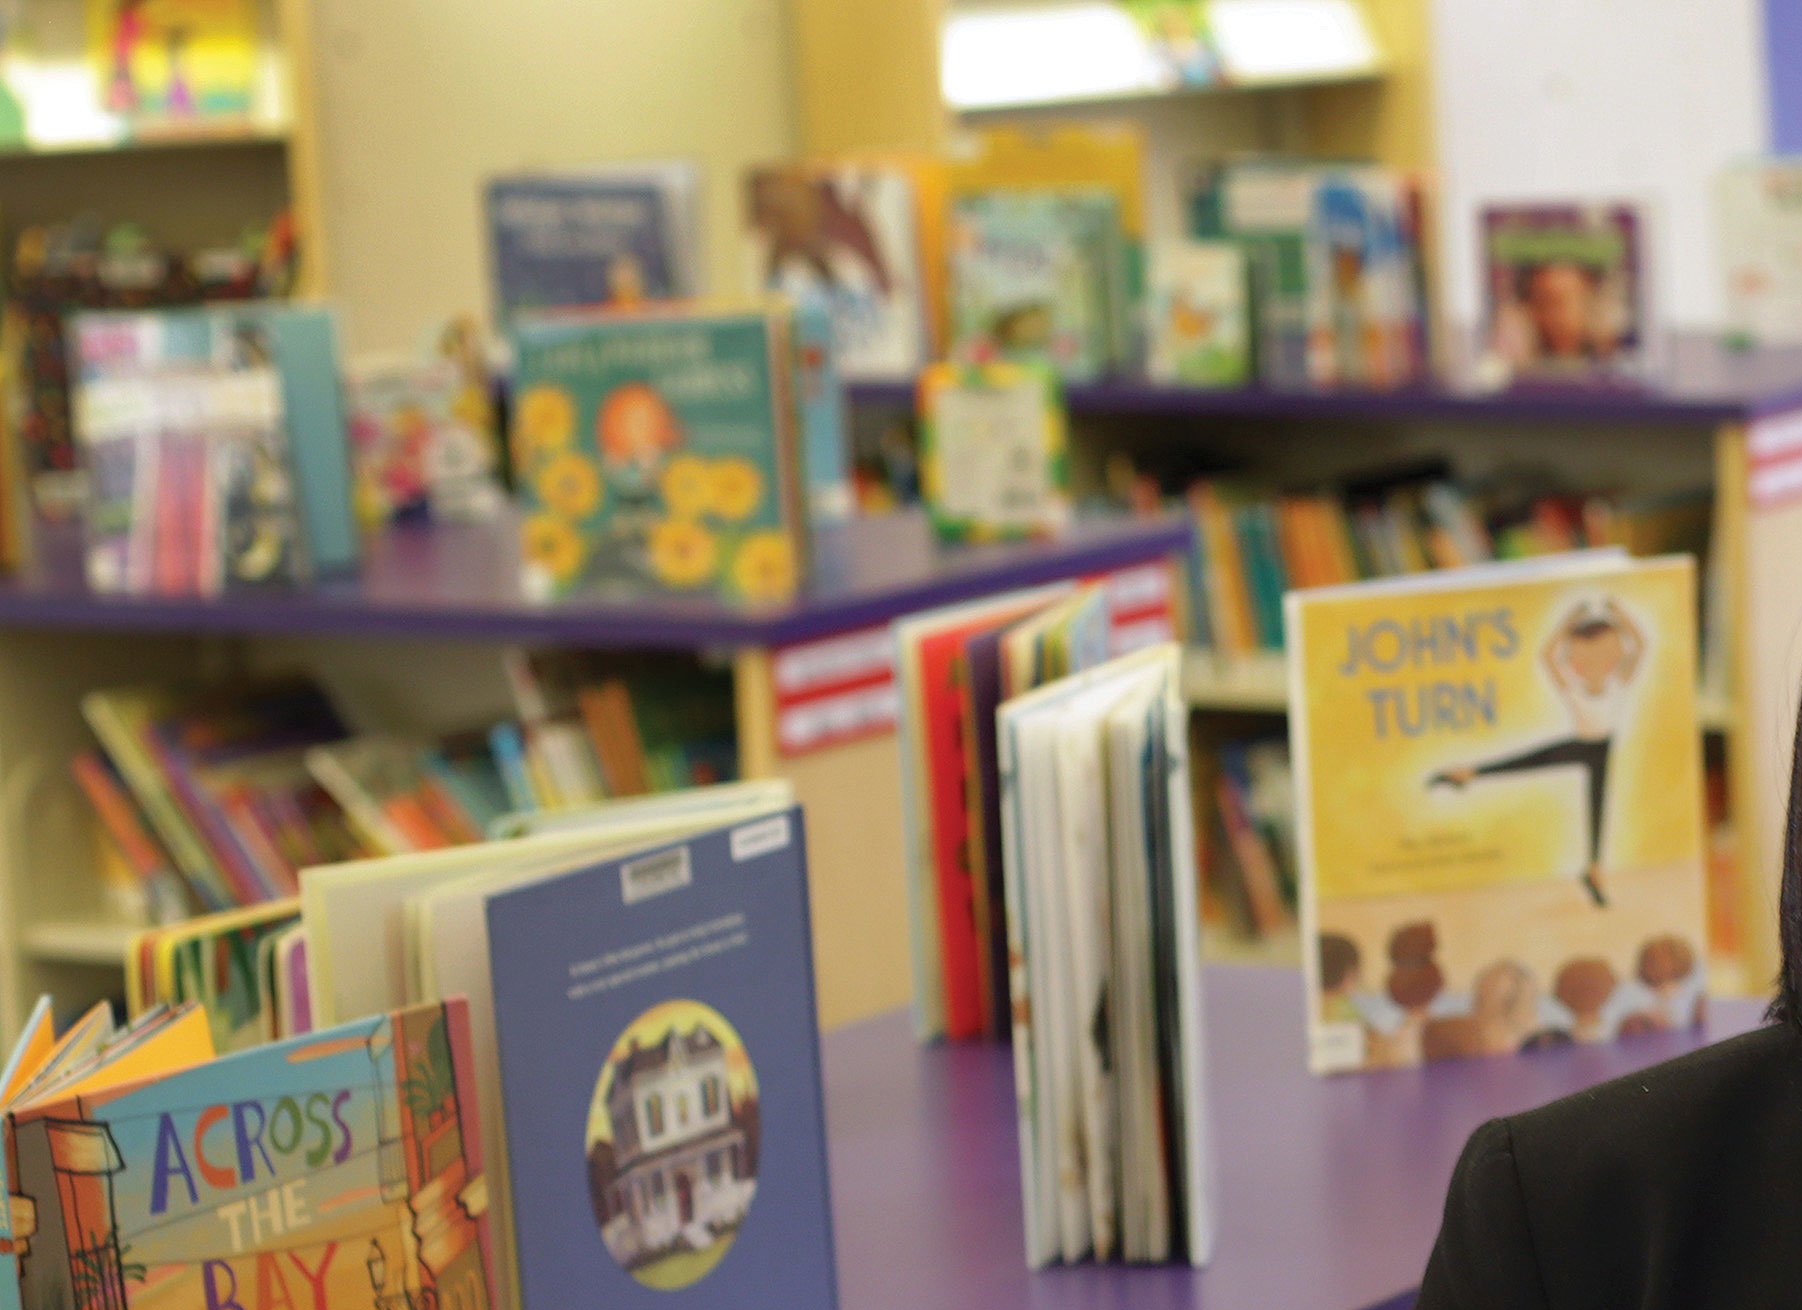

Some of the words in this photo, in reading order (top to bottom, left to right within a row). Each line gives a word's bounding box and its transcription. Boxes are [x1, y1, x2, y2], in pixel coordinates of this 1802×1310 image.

[1339, 607, 1520, 676] JOHN'S
[1366, 676, 1498, 738] TURN
[150, 1089, 352, 1214] ACROSS
[217, 1179, 312, 1252] THE
